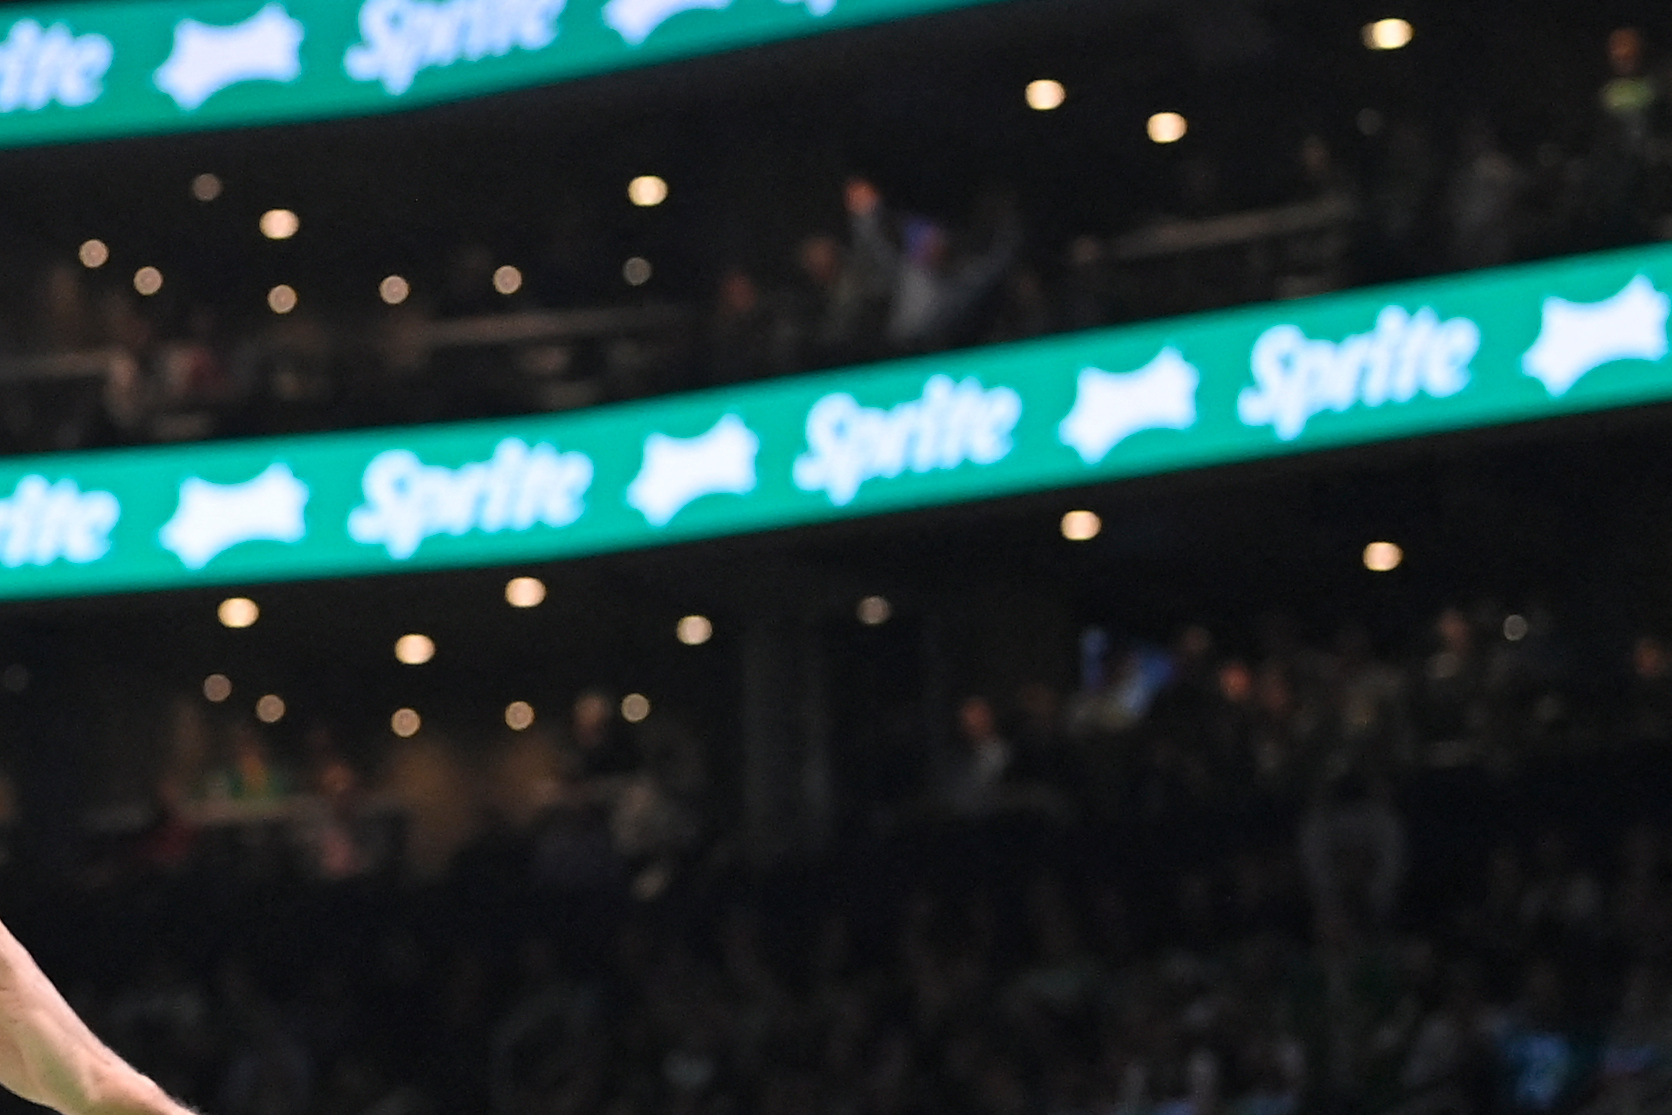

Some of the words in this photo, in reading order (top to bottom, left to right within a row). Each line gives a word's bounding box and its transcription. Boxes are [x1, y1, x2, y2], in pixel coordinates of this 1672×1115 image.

[347, 436, 595, 561] Sprite
[792, 374, 1022, 506] Sprite
[1236, 304, 1480, 440] Sprite
